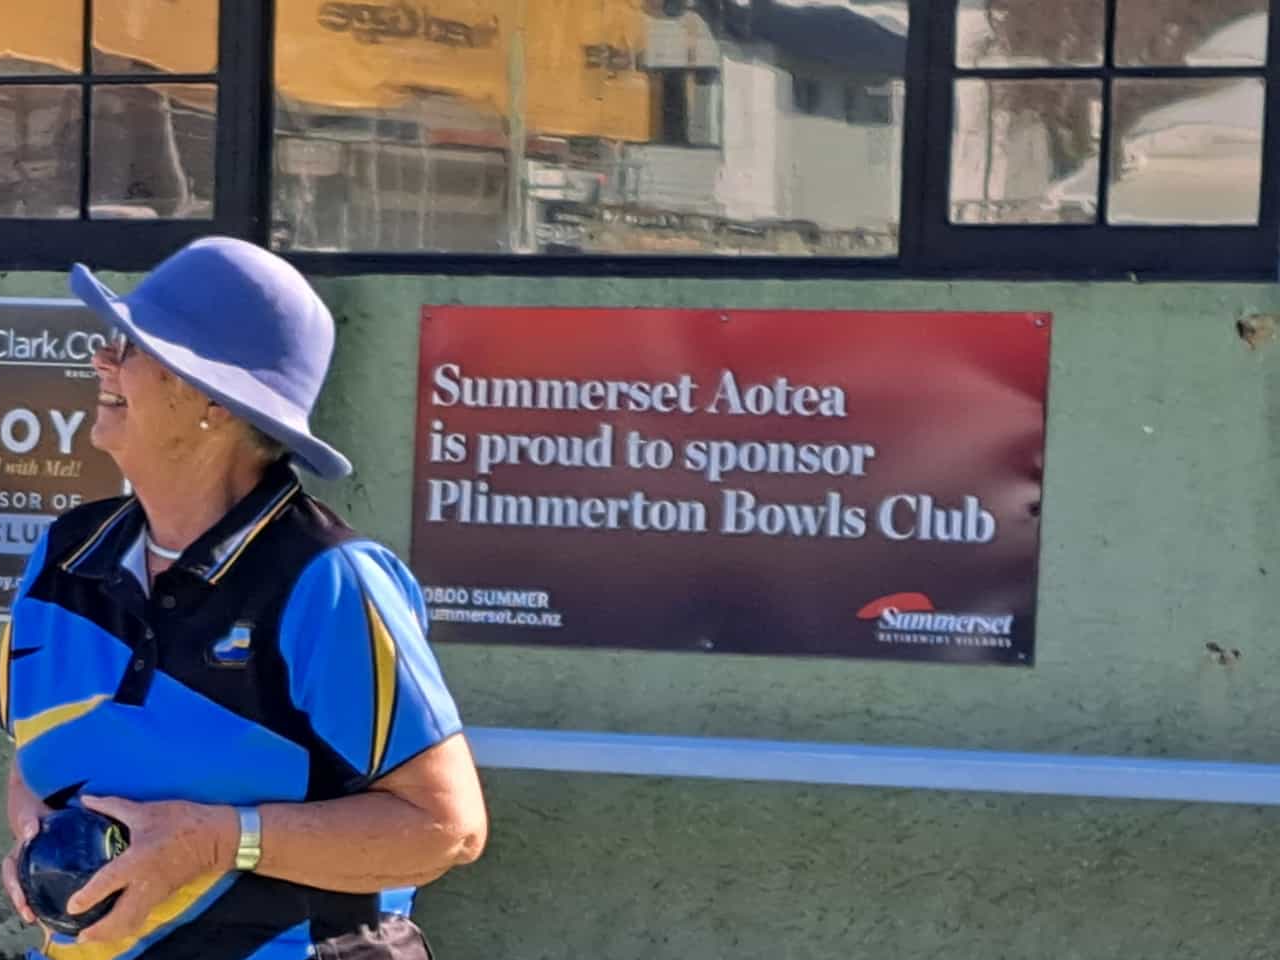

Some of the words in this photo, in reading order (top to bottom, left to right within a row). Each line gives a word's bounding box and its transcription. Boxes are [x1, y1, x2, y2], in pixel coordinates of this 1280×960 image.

[432, 363, 699, 414] Summerset
[706, 368, 848, 418] Aotea
[429, 420, 468, 463] is
[477, 423, 613, 475] proud
[626, 430, 674, 470] to
[683, 439, 875, 483] sponsor
[5, 459, 39, 476] with
[52, 494, 82, 510] OF
[426, 478, 709, 533] Plimmerton
[721, 489, 867, 538] Bowls
[878, 494, 997, 543] Club
[423, 588, 469, 605] 0800
[472, 590, 550, 608] SUMMER
[430, 608, 563, 627] ummerset.co.nz
[878, 606, 1014, 635] Summerset
